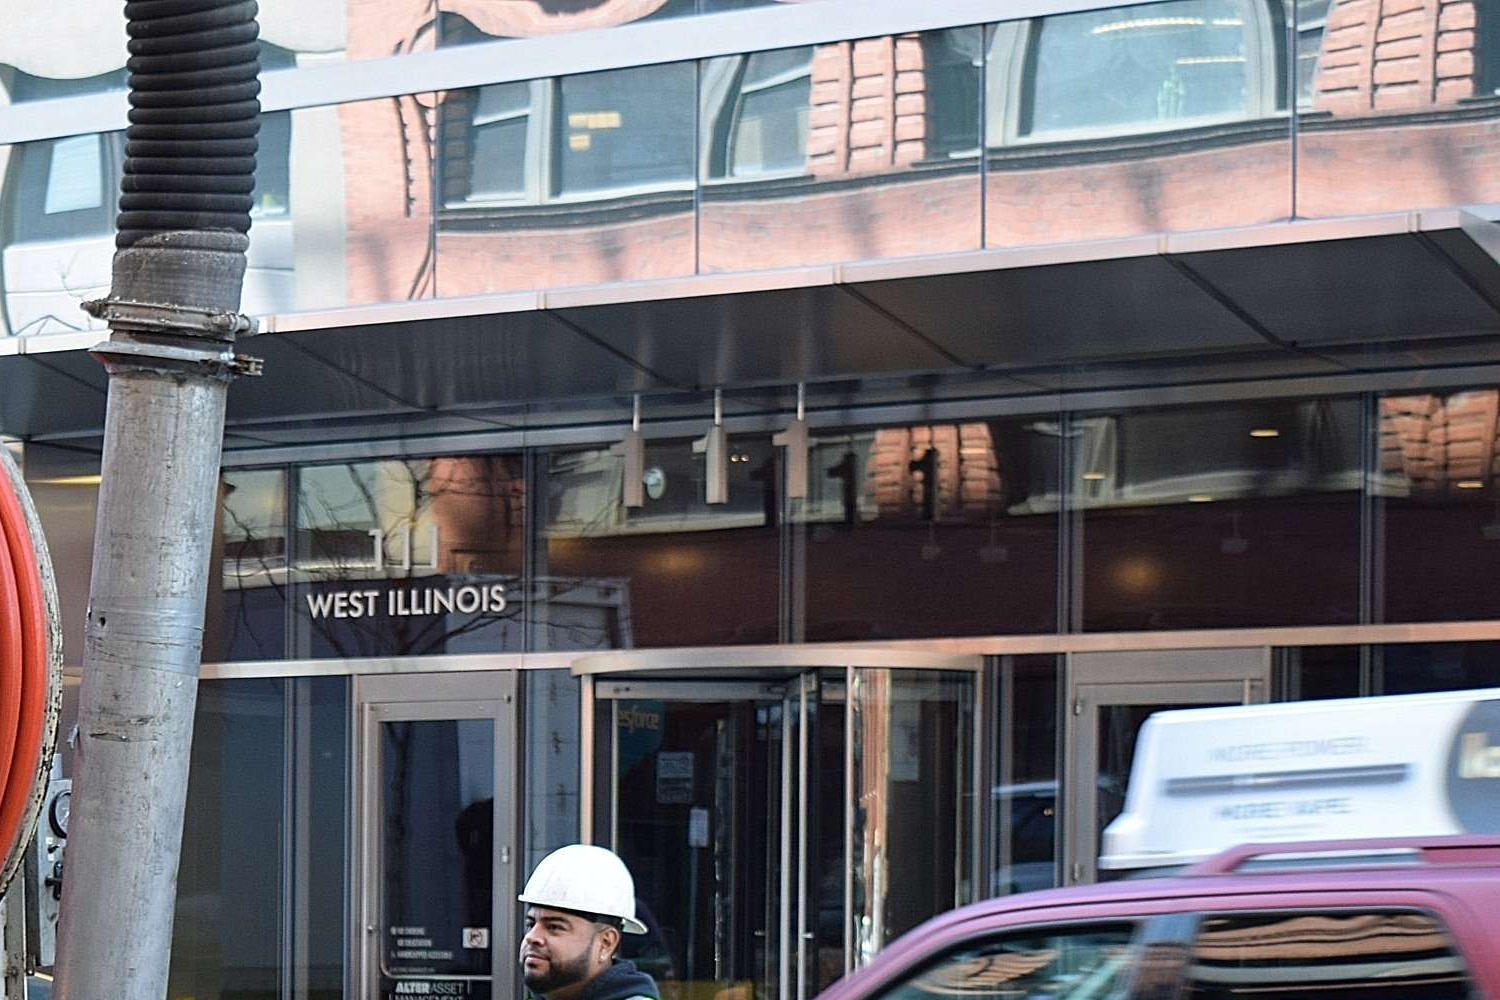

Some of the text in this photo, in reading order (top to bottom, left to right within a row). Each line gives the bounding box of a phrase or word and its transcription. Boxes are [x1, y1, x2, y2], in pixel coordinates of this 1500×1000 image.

[368, 524, 438, 571] 111
[306, 584, 507, 619] WEST ILLINOIS
[395, 981, 465, 995] ALTER ASSET
